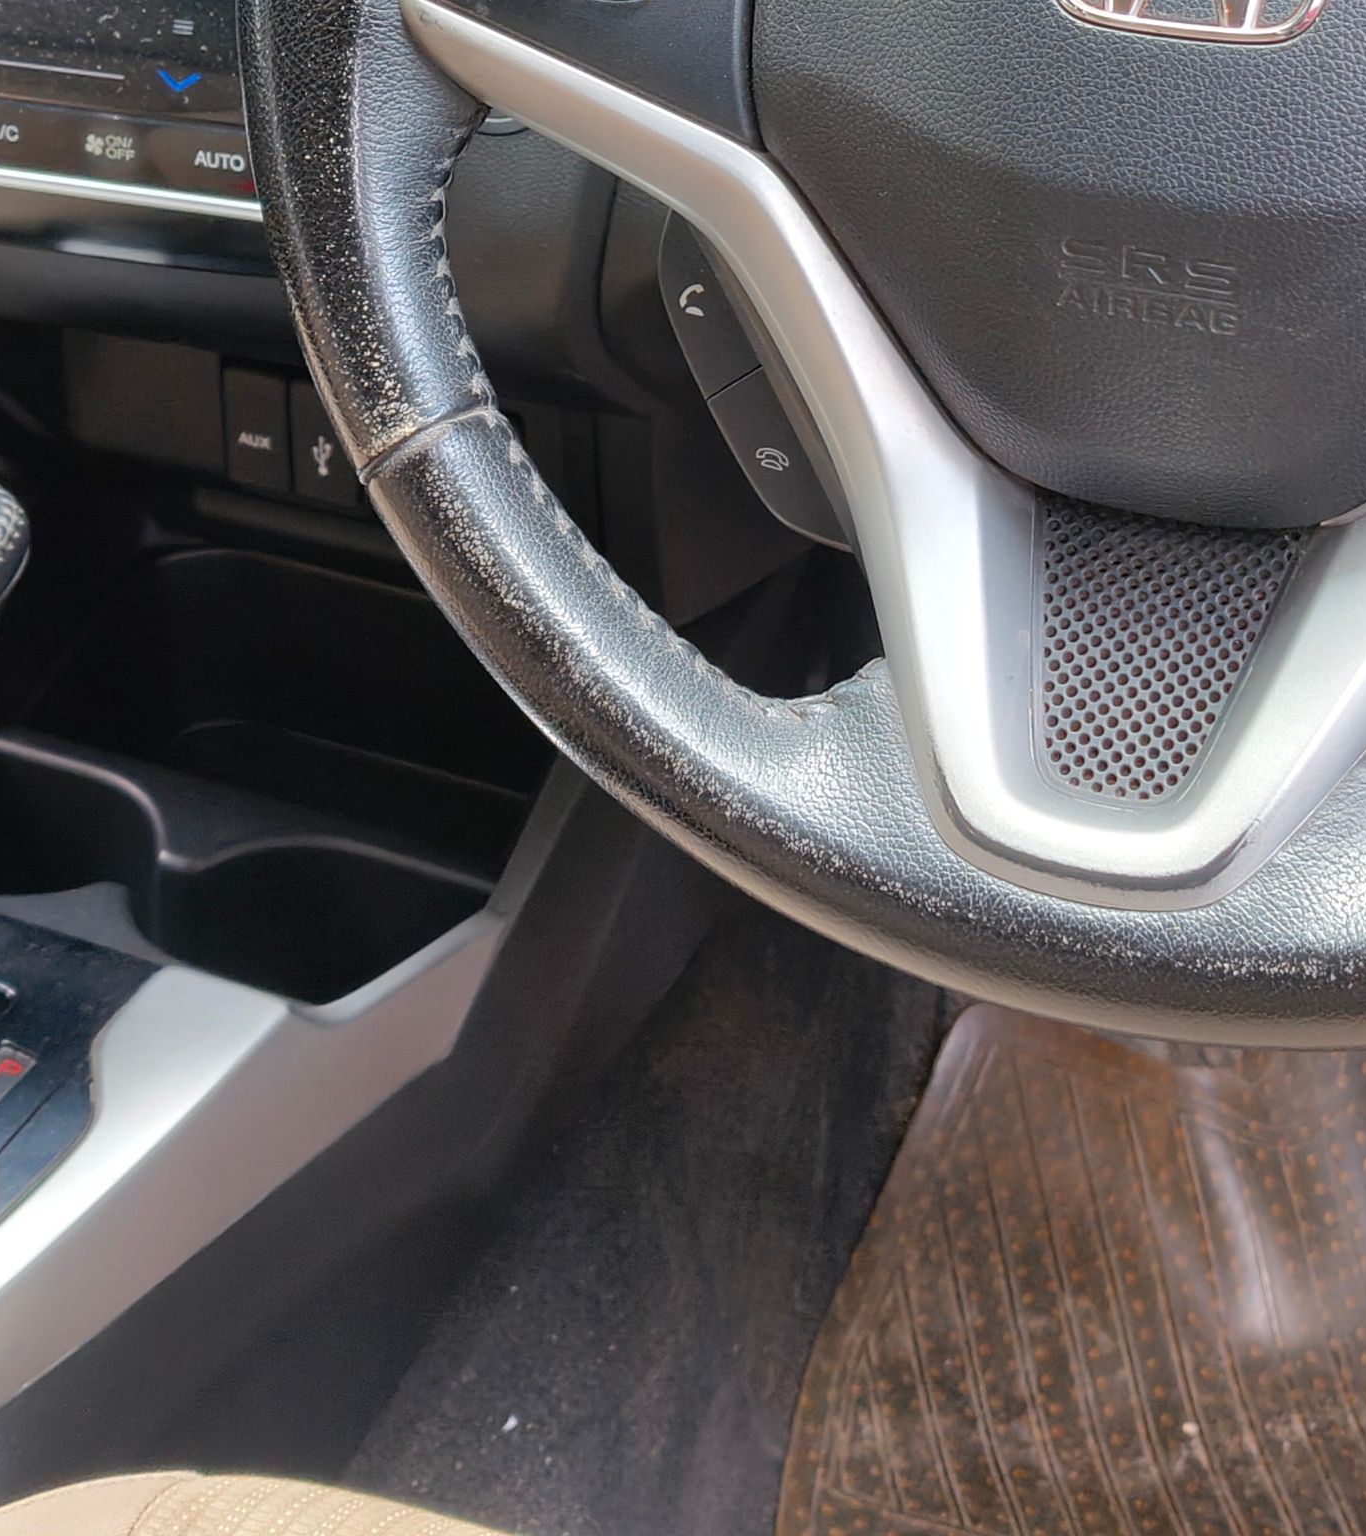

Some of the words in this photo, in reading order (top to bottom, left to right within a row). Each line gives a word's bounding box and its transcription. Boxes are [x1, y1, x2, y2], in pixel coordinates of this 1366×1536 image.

[105, 147, 135, 161] OFF
[194, 150, 245, 172] AUTO
[1059, 236, 1237, 295] SRS
[238, 431, 271, 450] AUX
